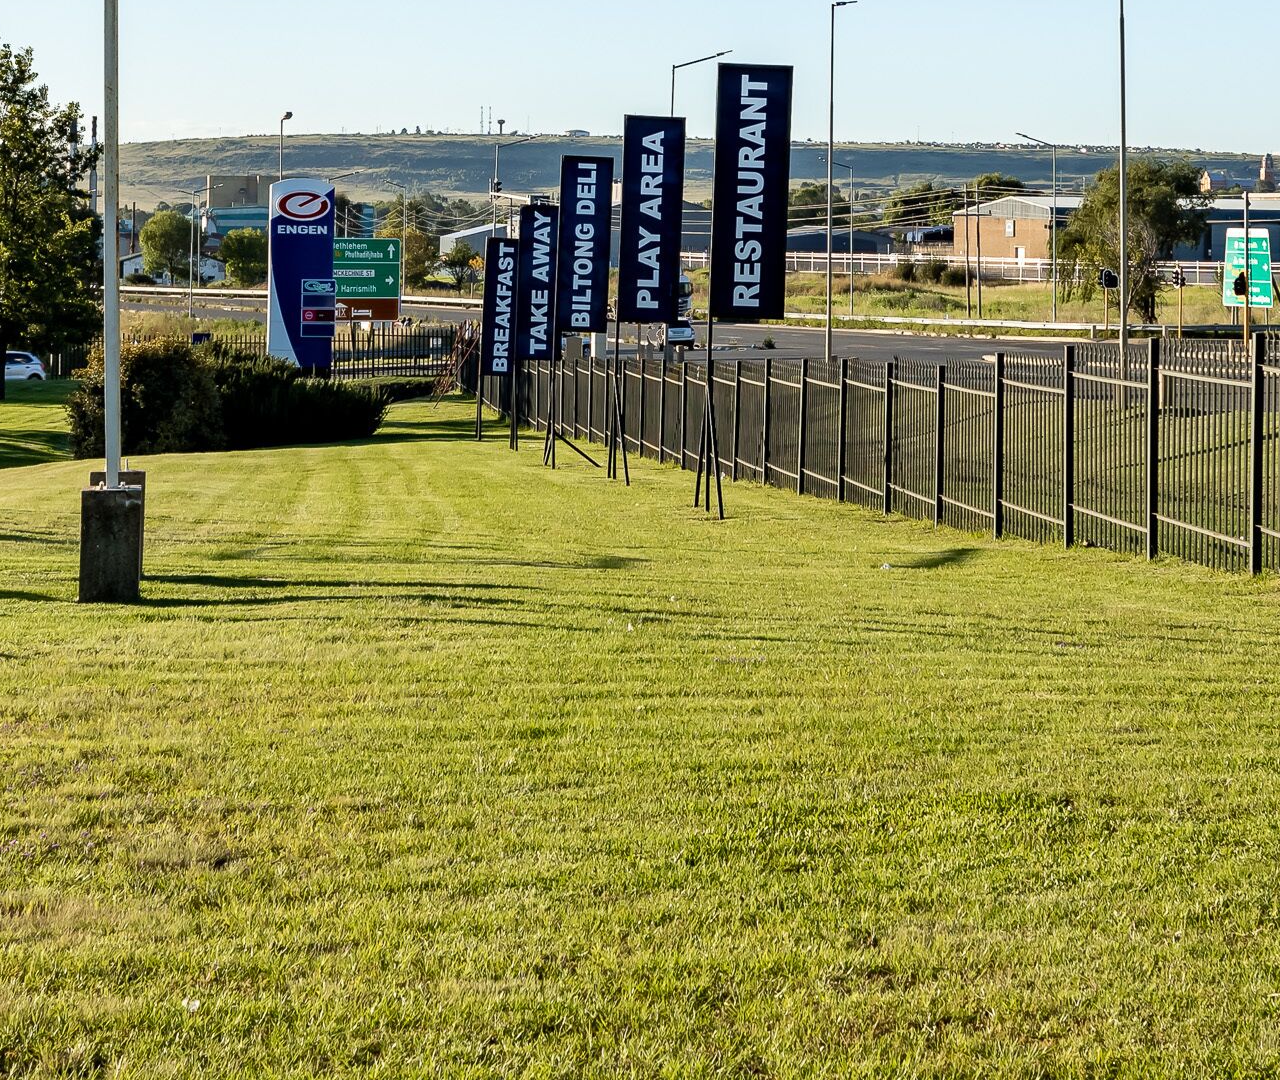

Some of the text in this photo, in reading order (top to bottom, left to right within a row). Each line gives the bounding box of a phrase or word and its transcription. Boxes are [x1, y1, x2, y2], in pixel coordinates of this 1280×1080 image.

[277, 224, 328, 235] ENGEN
[571, 162, 597, 327] BILTONG DELI
[636, 130, 665, 309] PLAY AREA
[732, 74, 768, 307] RESTAURANT
[340, 284, 377, 293] Harrismith
[492, 242, 515, 372] BREAKFAST
[529, 211, 551, 355] TAKE AWAY
